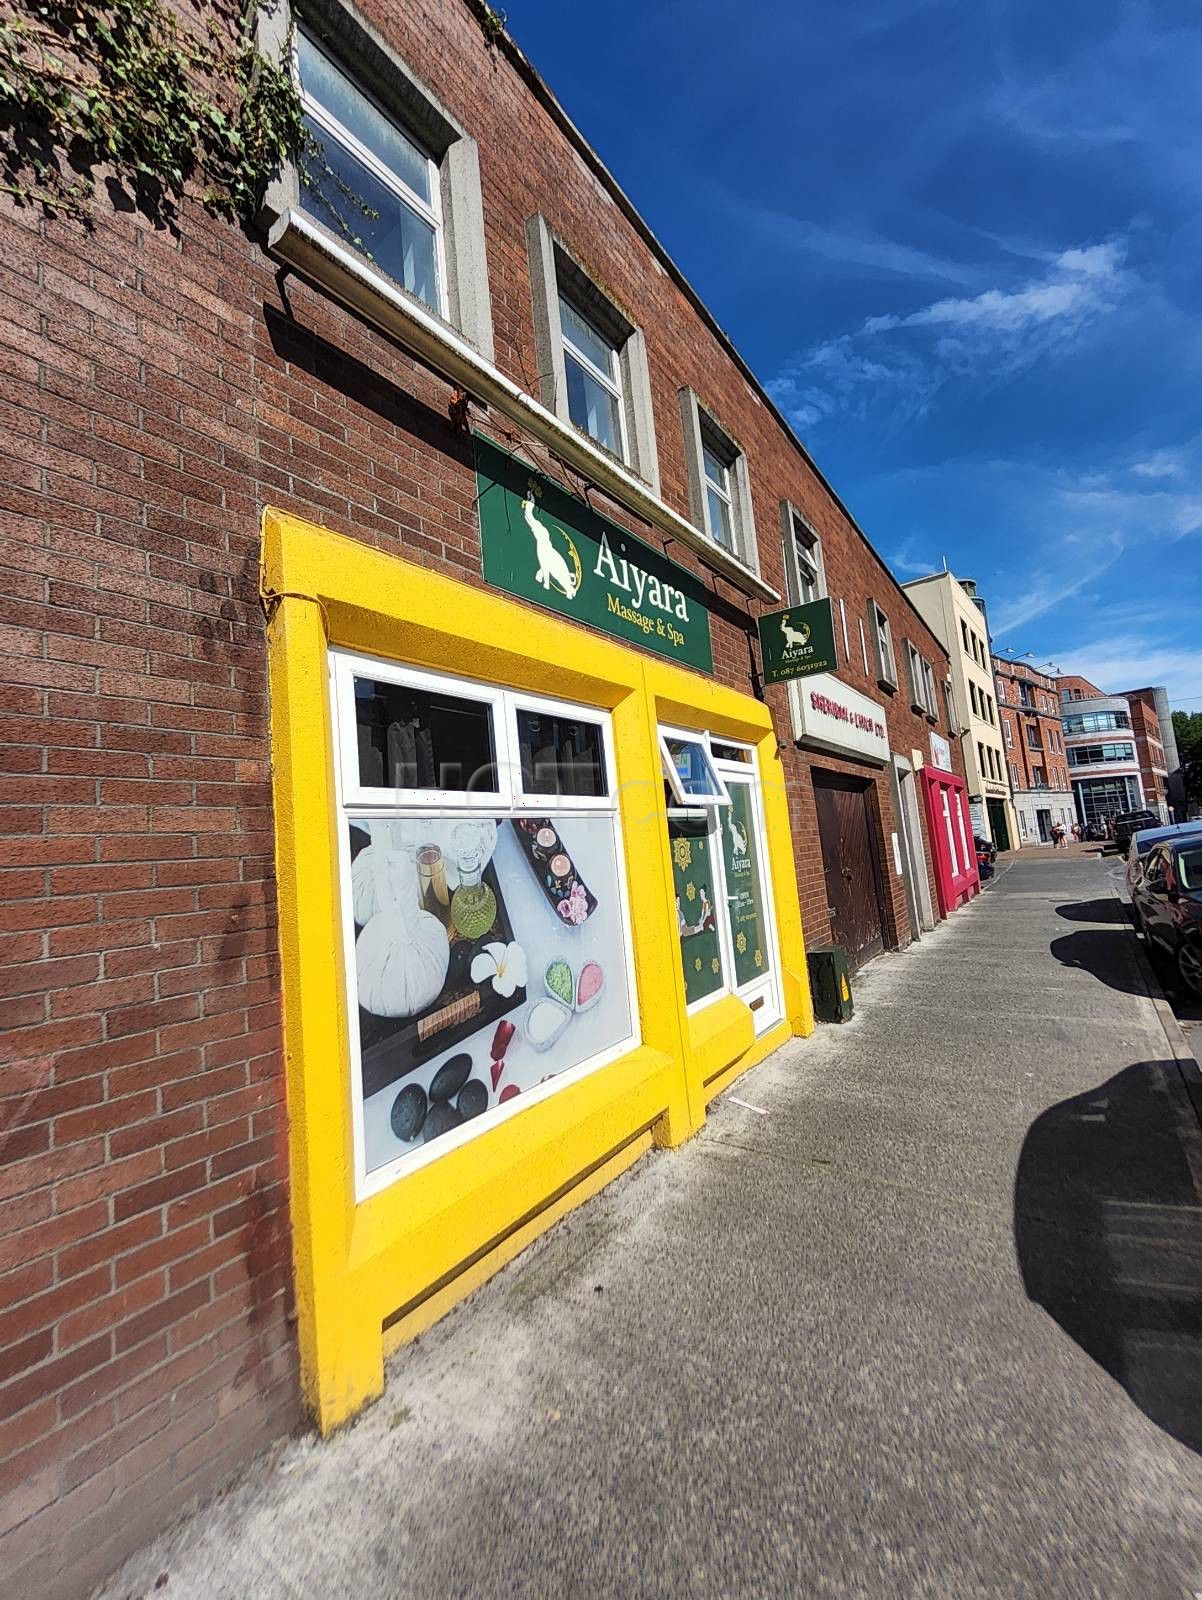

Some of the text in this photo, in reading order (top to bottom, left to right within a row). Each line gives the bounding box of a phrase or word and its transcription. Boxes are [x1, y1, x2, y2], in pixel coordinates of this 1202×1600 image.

[593, 531, 690, 622] Aiyara
[607, 593, 685, 647] Massage & Spa
[781, 645, 814, 660] Aiyara
[780, 667, 795, 676] 087
[731, 857, 752, 873] Aiyara
